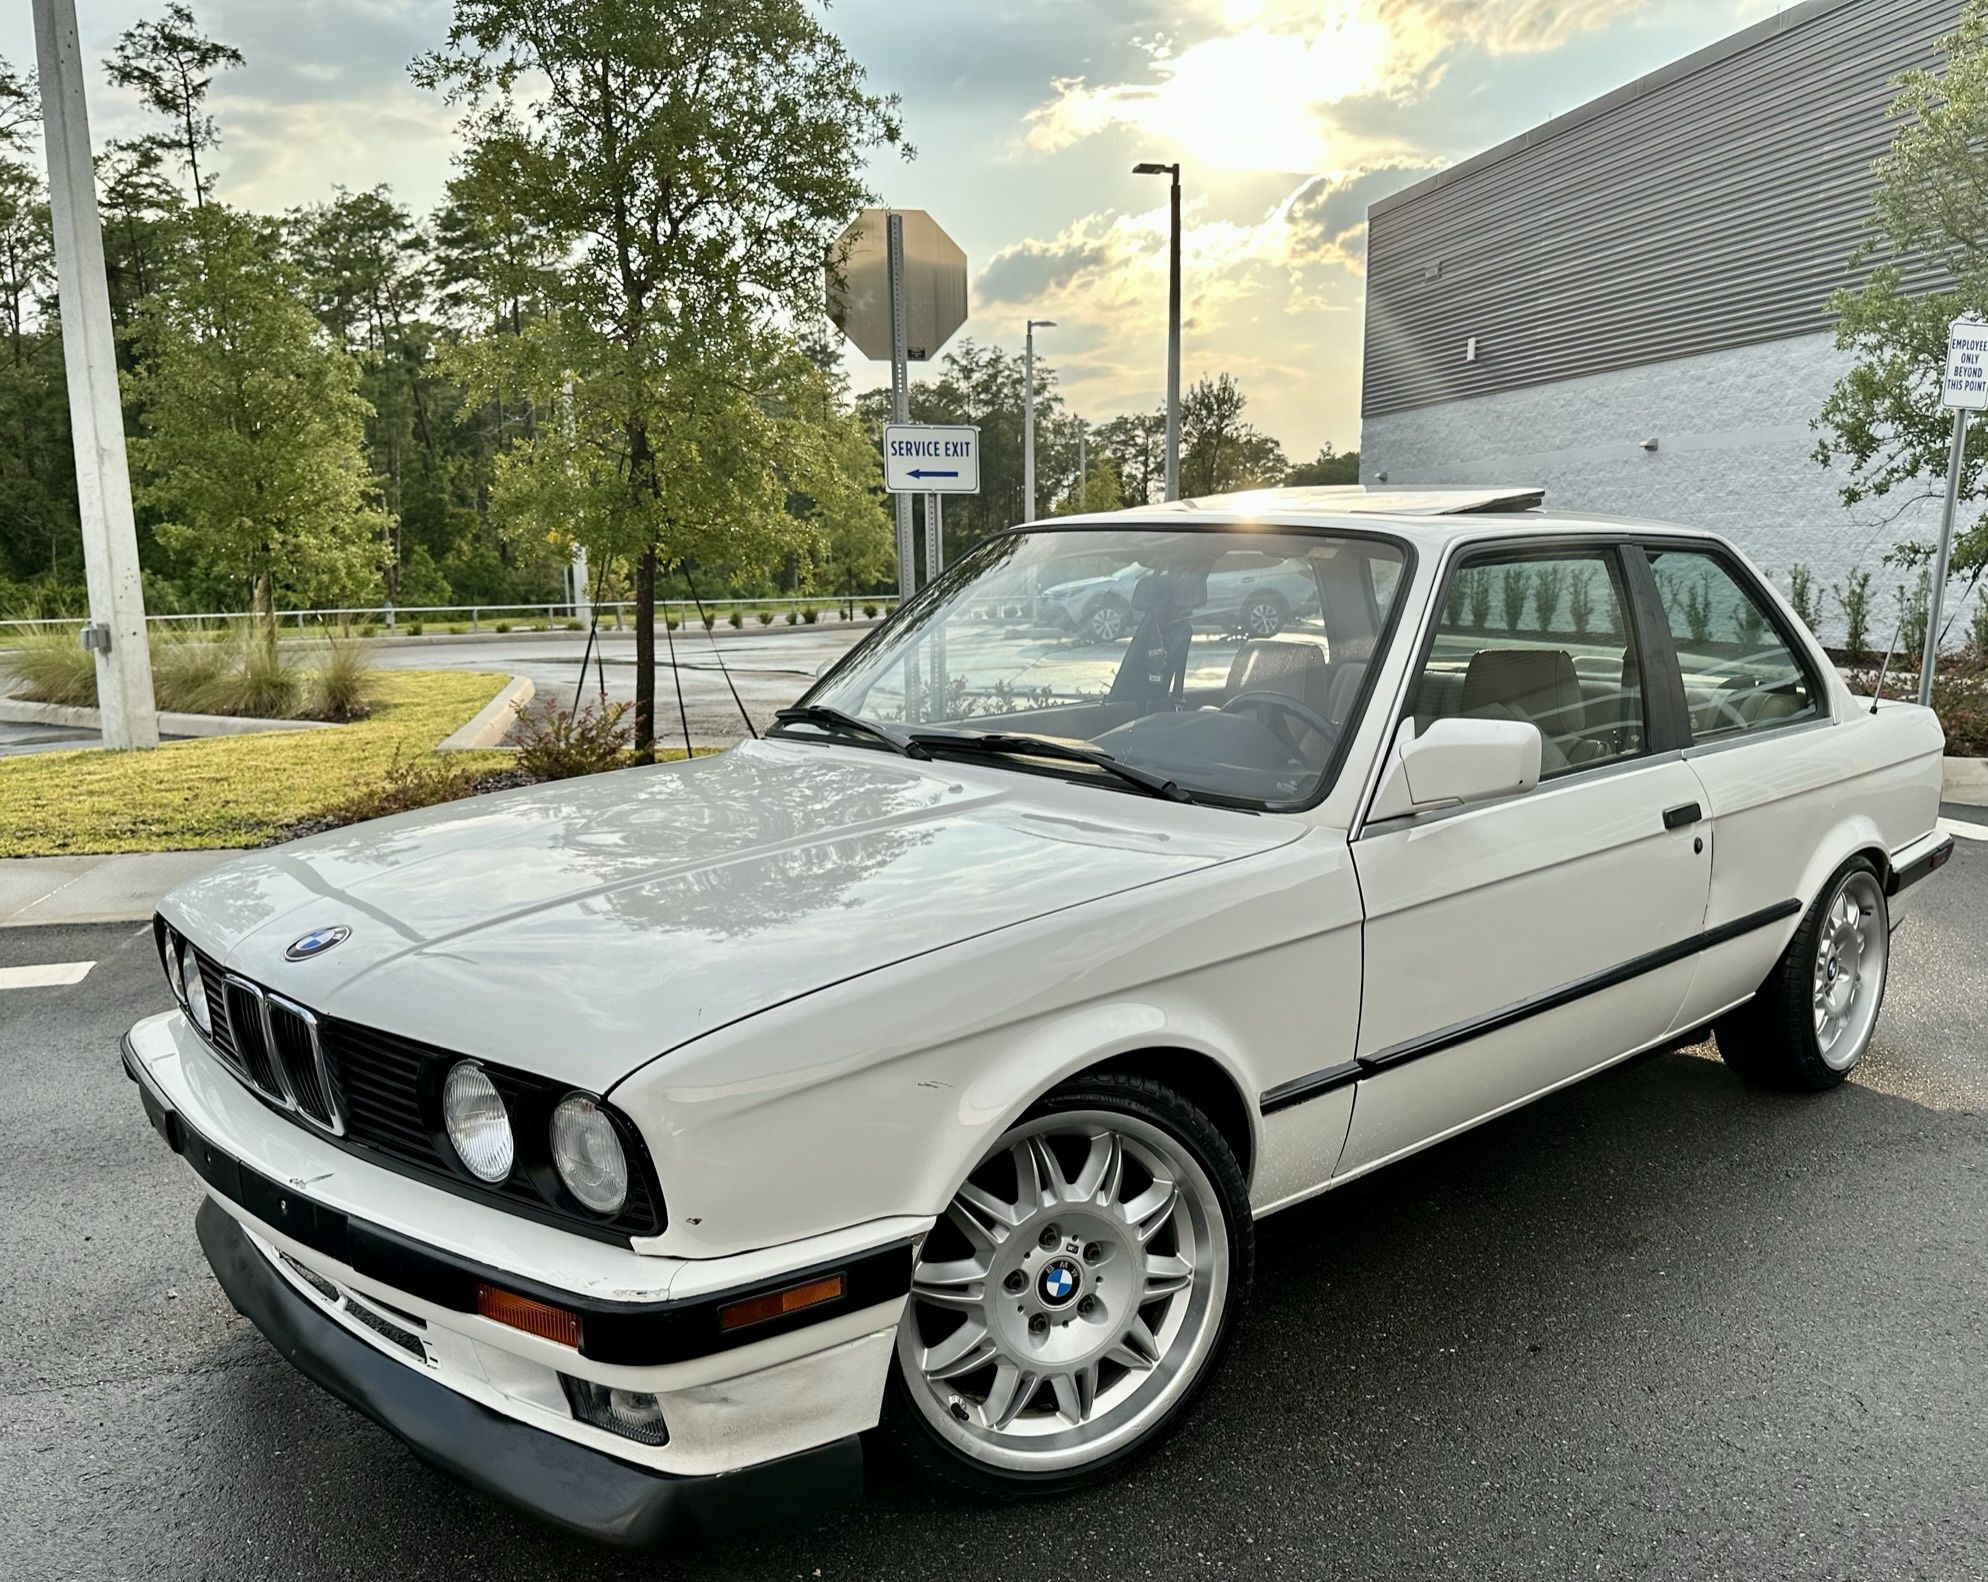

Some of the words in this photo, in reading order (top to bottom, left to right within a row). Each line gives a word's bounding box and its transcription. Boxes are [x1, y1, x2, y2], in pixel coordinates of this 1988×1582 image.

[1951, 338, 1988, 351] EMPLOYEE
[1961, 353, 1980, 365] ONLY
[1954, 366, 1983, 378] BEYOND
[1947, 379, 1963, 390] THIS
[1964, 381, 1987, 392] POINT
[891, 440, 940, 457] SERVICE
[944, 441, 971, 457] EXIT
[1045, 1260, 1079, 1278] BMW
